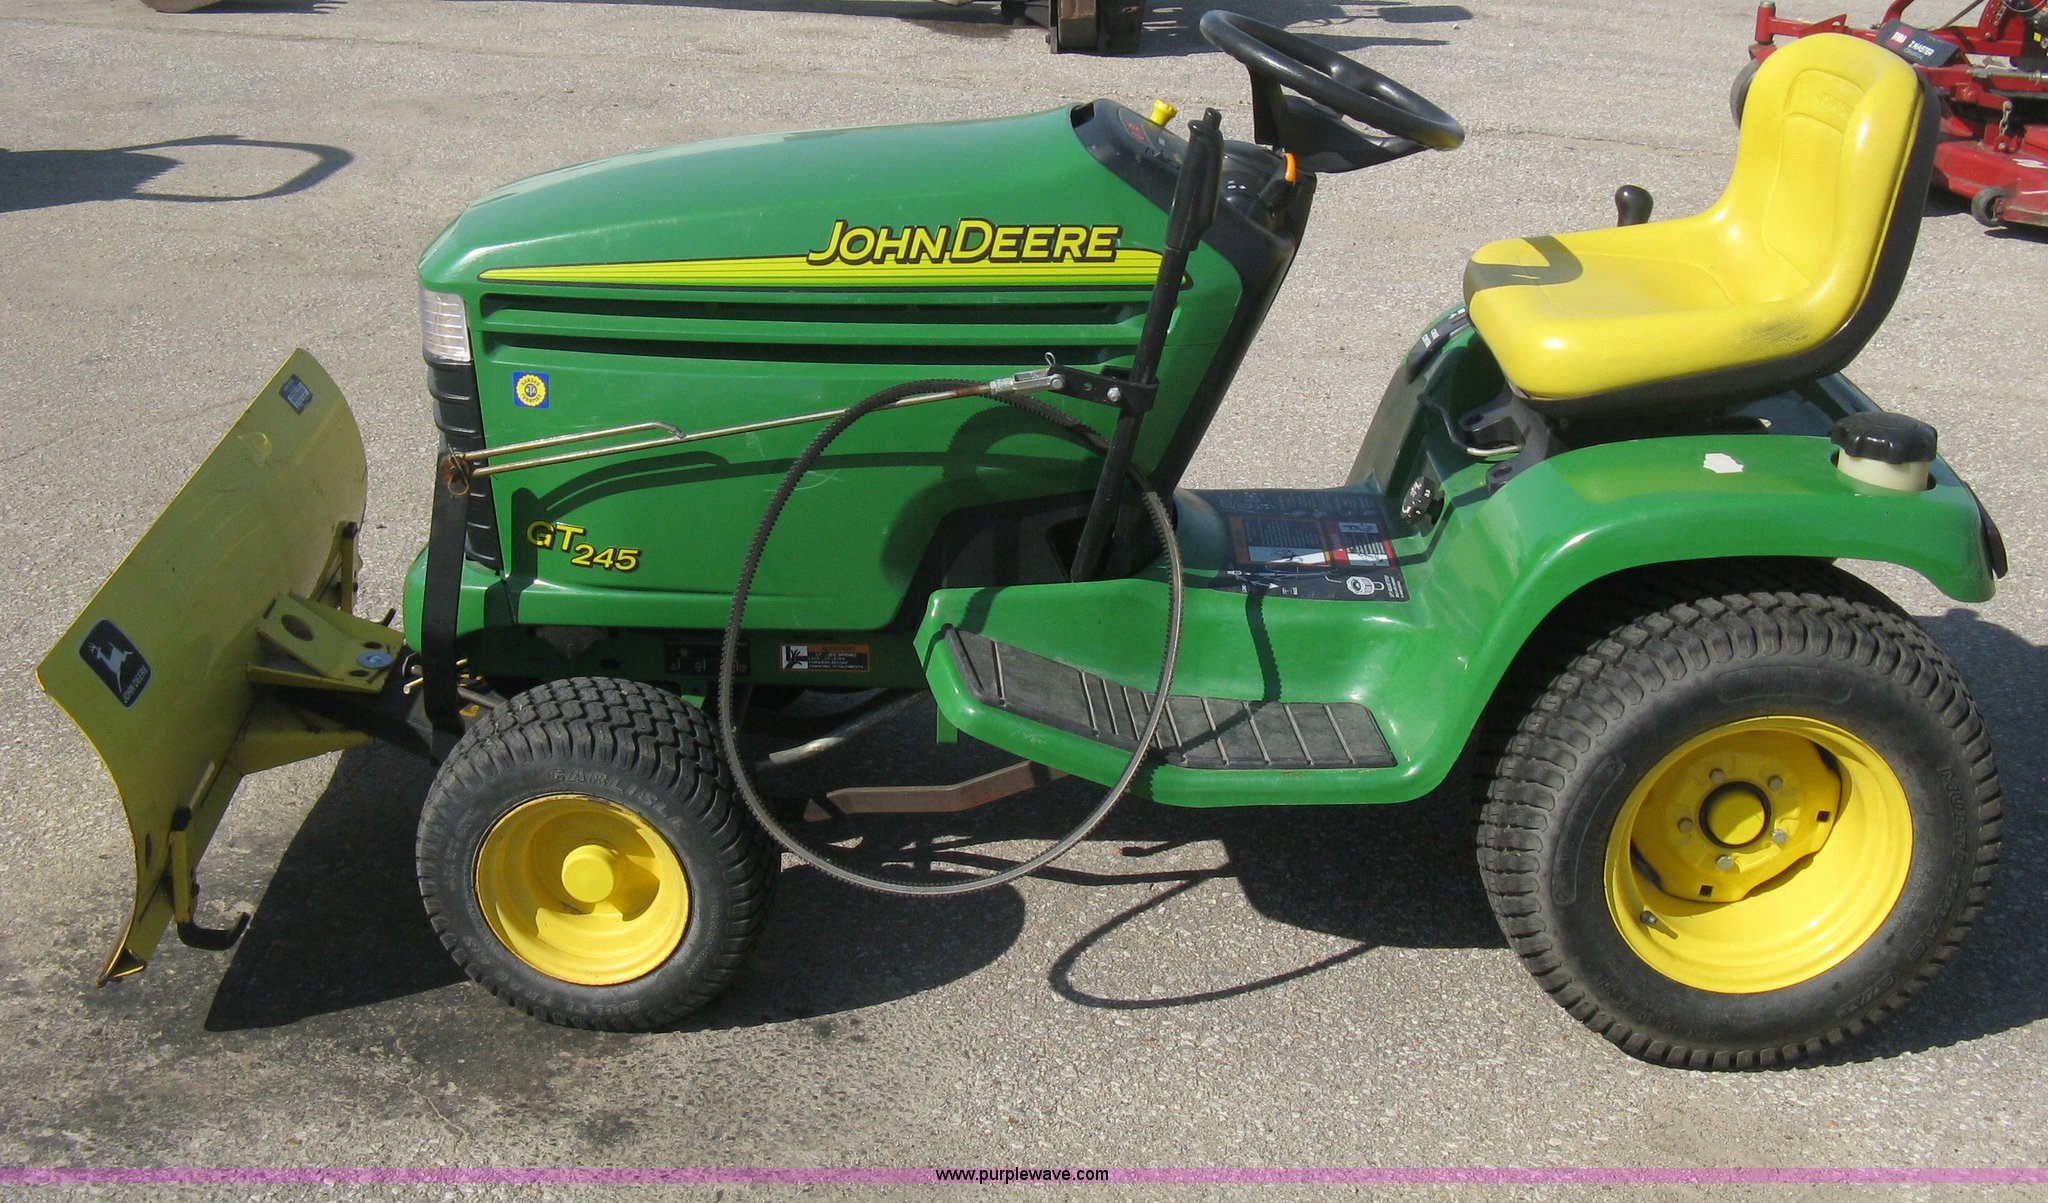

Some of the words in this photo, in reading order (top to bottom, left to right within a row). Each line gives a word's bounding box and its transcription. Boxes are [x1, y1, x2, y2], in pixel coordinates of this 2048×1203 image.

[806, 218, 950, 265] JOHN
[950, 217, 1122, 264] DEERE
[526, 520, 585, 551] GT
[571, 542, 642, 572] 245
